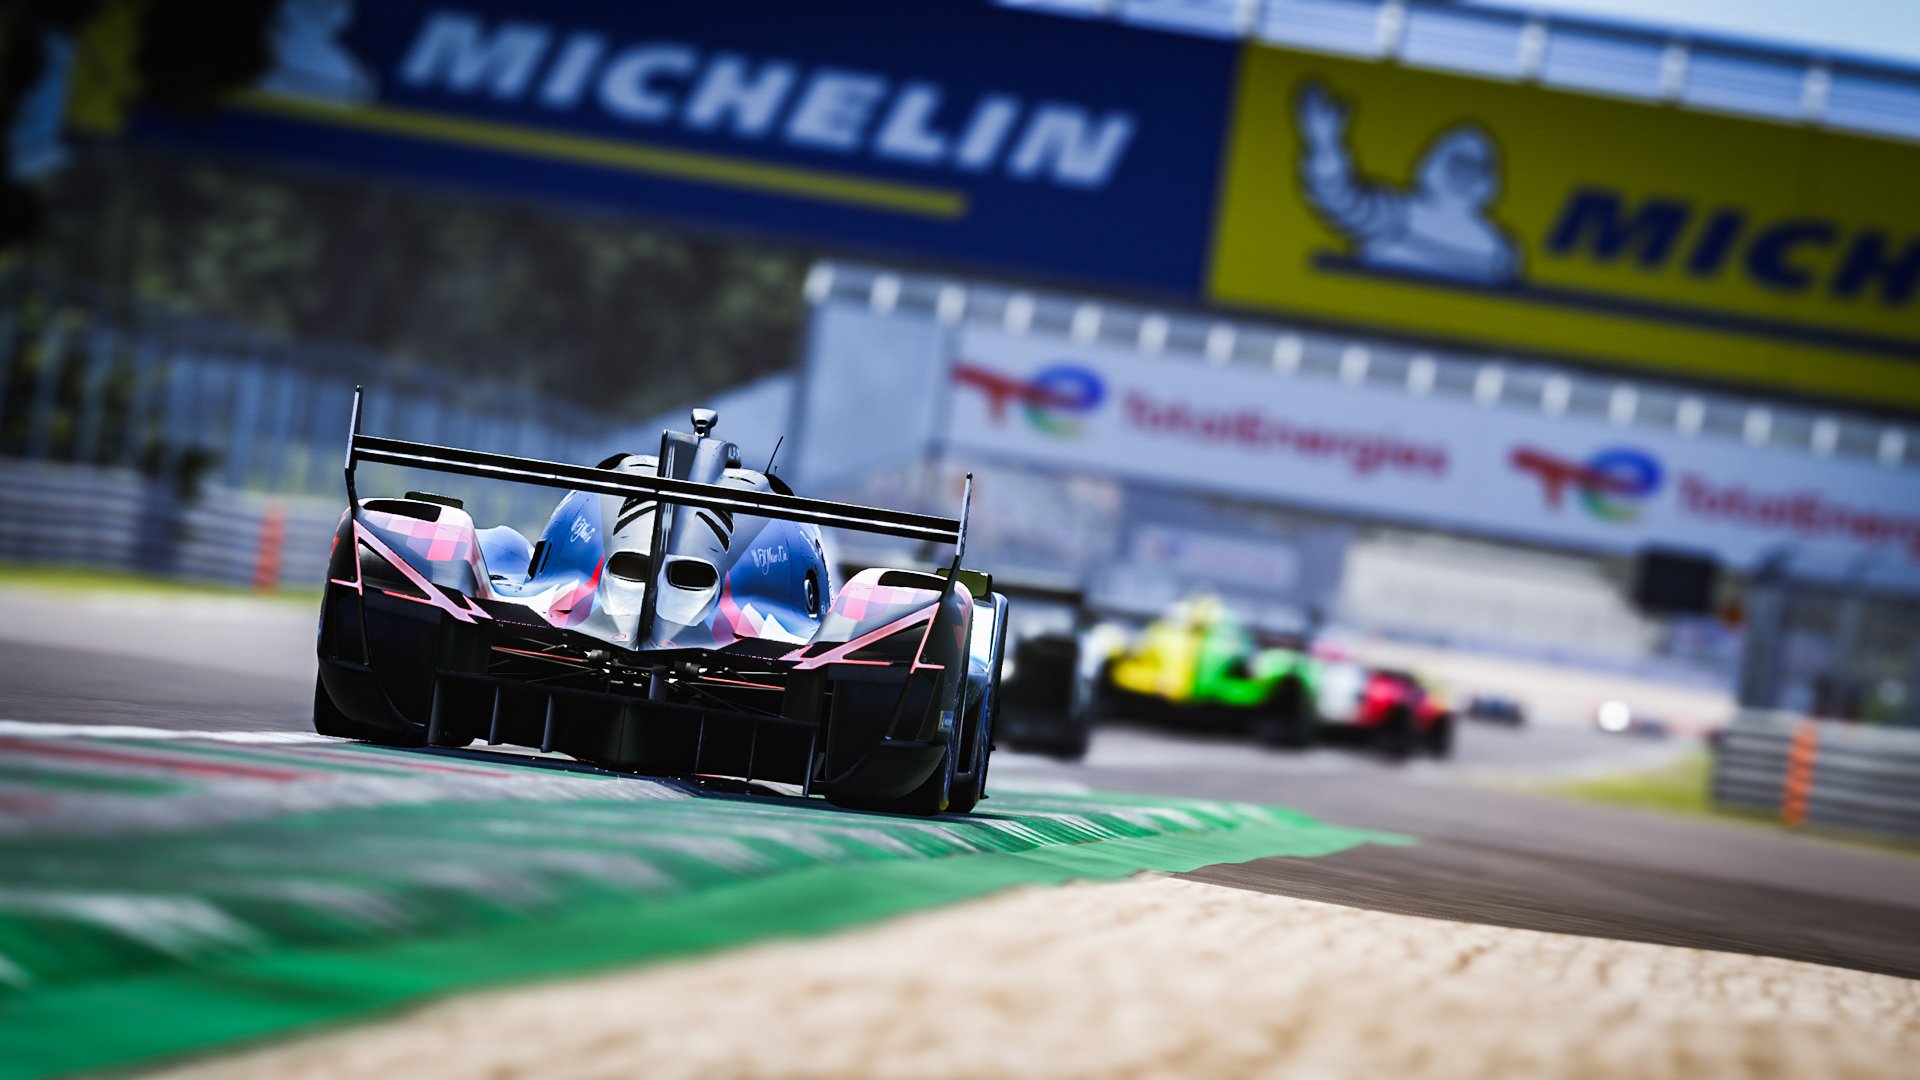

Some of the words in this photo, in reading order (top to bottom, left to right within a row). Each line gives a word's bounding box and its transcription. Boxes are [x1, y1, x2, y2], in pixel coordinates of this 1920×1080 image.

[402, 11, 1138, 189] MICHELIN
[1543, 185, 1920, 309] MICH
[1124, 389, 1451, 479] TotalEnergies
